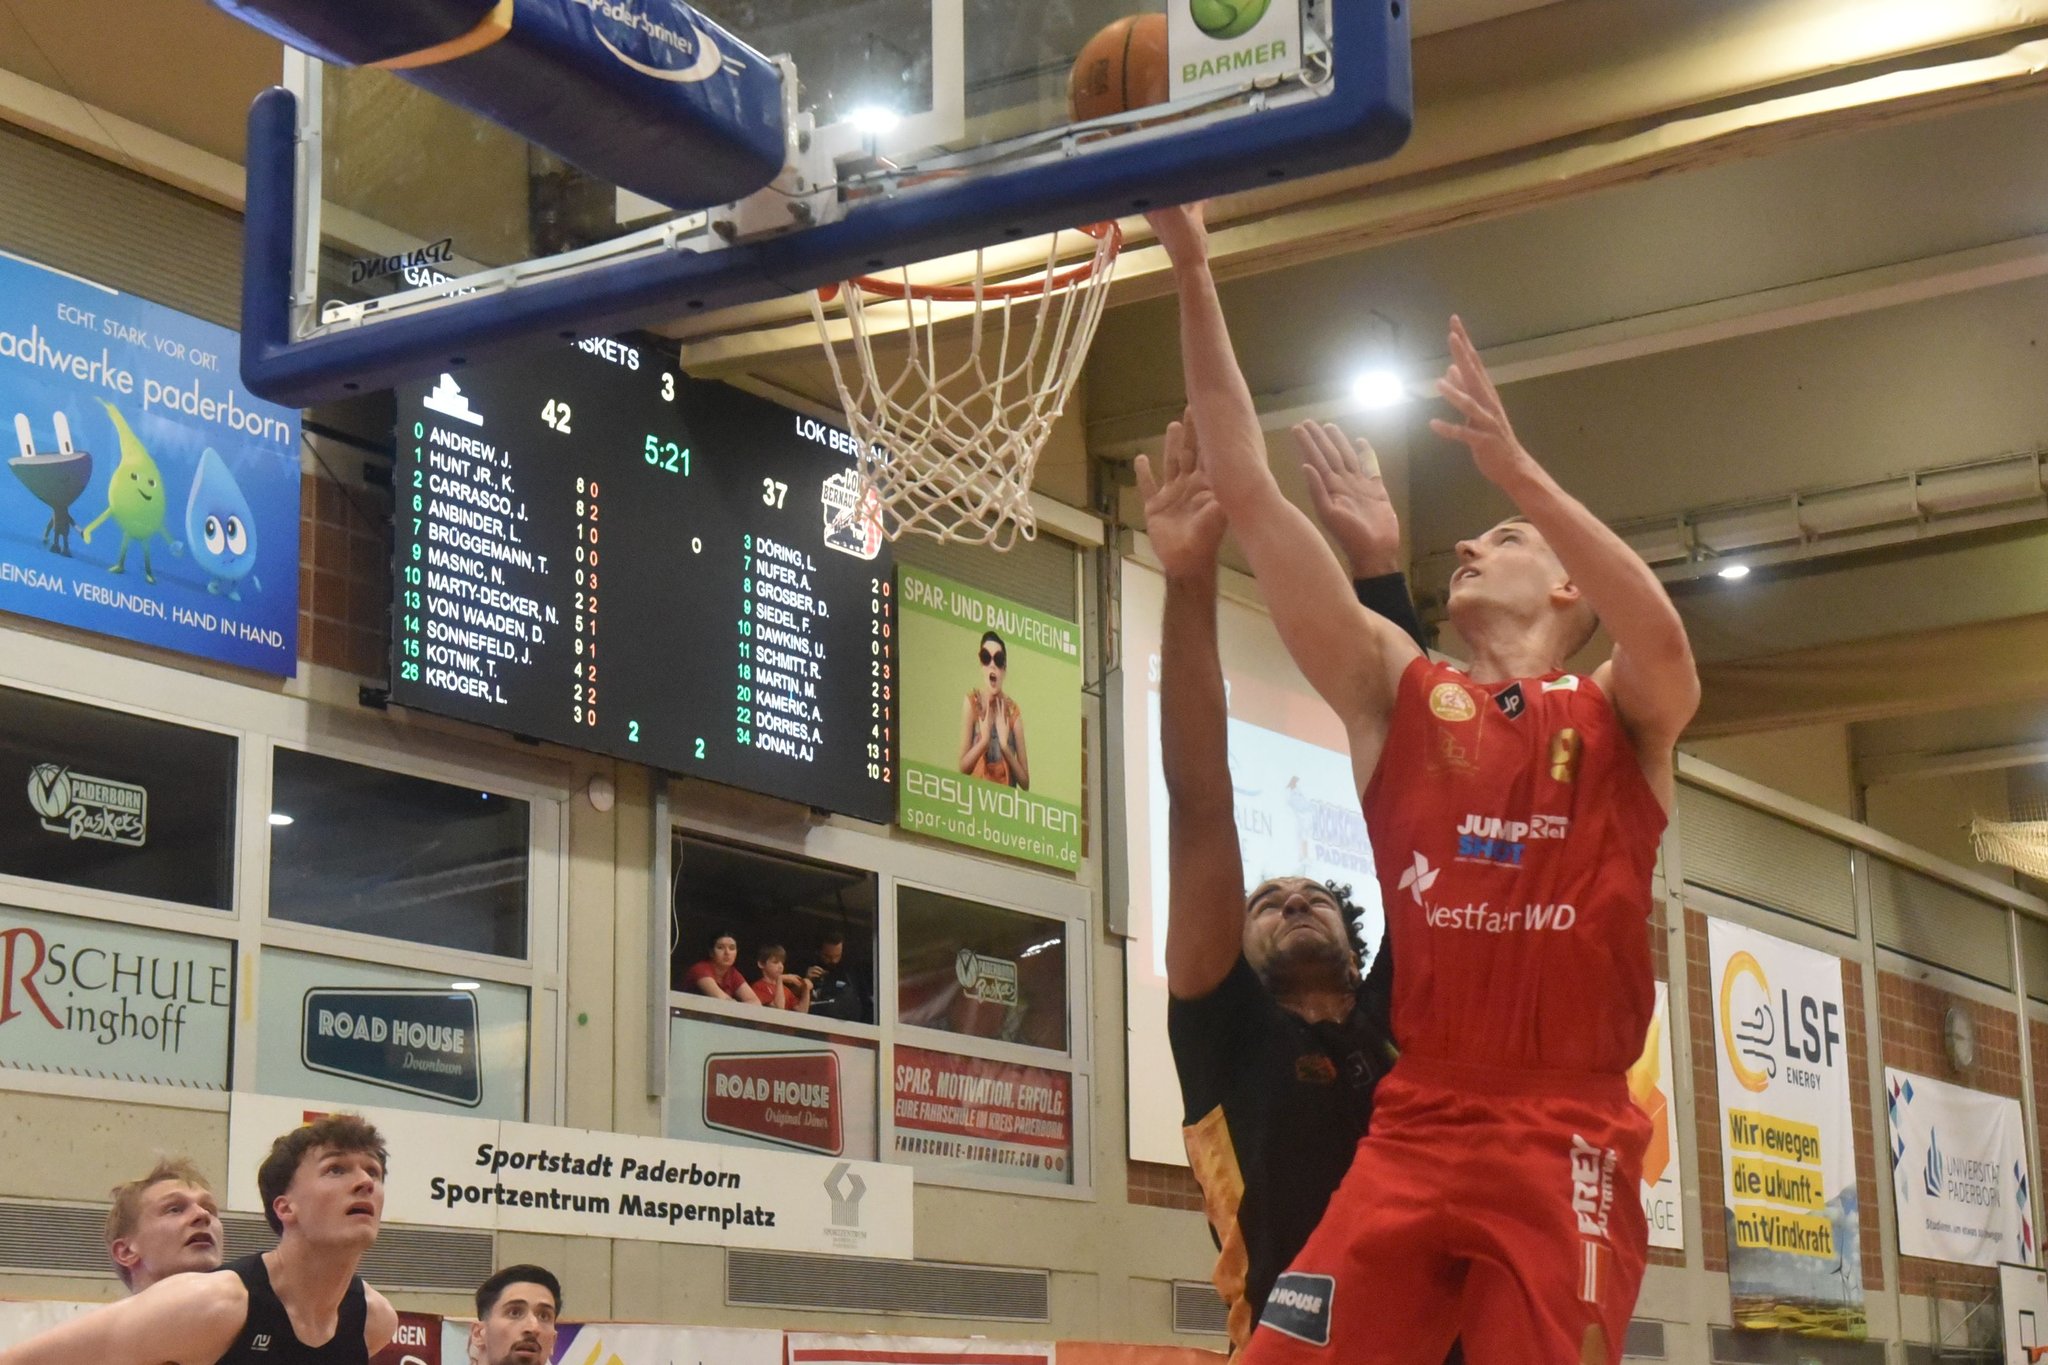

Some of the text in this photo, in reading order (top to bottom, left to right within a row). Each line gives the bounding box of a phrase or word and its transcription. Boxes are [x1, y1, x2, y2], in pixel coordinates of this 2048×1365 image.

[1182, 40, 1287, 84] BARMER
[57, 303, 220, 372] ECHT. STARK. VOR ORT.
[661, 372, 675, 401] 3
[144, 378, 290, 445] paderborn
[541, 399, 571, 435] 42
[415, 422, 512, 470] 0 ANDREW, J.
[796, 416, 826, 445] LOK
[416, 448, 516, 494] 1 HUNT JR., K.
[644, 435, 690, 477] 5:21
[414, 471, 529, 522] 2 CARRASCO, J.
[576, 478, 584, 493] 8
[763, 478, 788, 509] 37
[414, 495, 522, 543] 6 ANBINDER, L.
[576, 500, 584, 516] 8
[413, 518, 550, 574] 7 BRÜGGEMANN, T.
[576, 546, 584, 562] 0
[692, 537, 702, 553] 0
[744, 534, 816, 572] 3 DÖRING, L.
[412, 544, 506, 586] 9 MASNIC, N.
[576, 570, 584, 585] 0
[744, 556, 812, 592] 7 NUFER, A.
[404, 566, 560, 625] 10 MARTY-DECKER, N.
[576, 592, 583, 609] 2
[744, 578, 830, 618] 8 GROSBER, D.
[872, 578, 878, 593] 2
[73, 580, 285, 650] VERBUNDEN. HAND IN HAND.
[404, 590, 546, 644] 13 VON WAADEN, D.
[576, 616, 583, 632] 5
[744, 600, 812, 634] 9 SIEDEL, F.
[872, 620, 878, 634] 2
[904, 576, 1063, 651] SPAR- UND BAUVEREIN
[404, 615, 532, 665] 14 SONNEFELD, J.
[576, 638, 583, 654] 9
[738, 620, 826, 660] 10 DAWKINS, U.
[403, 638, 498, 678] 15 KOTNIK, T.
[574, 662, 582, 678] 4
[738, 642, 822, 680] 11 SCHMITT, R.
[872, 662, 878, 676] 2
[402, 662, 508, 704] 26 KRÖGER, L.
[574, 684, 582, 700] 2
[738, 664, 816, 698] 18 MARTIN, M.
[872, 682, 879, 697] 2
[574, 706, 582, 722] 3
[737, 684, 823, 722] 20 KAMERIC, A.
[872, 703, 878, 718] 2
[628, 720, 639, 743] 2
[737, 707, 823, 744] 22 DÖRRIES, A.
[872, 724, 878, 738] 4
[695, 738, 705, 759] 2
[737, 728, 814, 762] 34 JONAH, AJ
[867, 743, 879, 758] 13
[867, 763, 879, 779] 10
[72, 779, 143, 810] PADERBORN
[906, 768, 1078, 837] easy wohnen
[65, 806, 145, 840] Baskets
[907, 806, 1078, 864] spar-und-bauverein.de
[1456, 814, 1529, 842] JUMP
[1457, 834, 1526, 864] SHOT
[318, 1009, 465, 1054] ROAD HOUSE
[1781, 988, 1840, 1068] LSF
[403, 1051, 462, 1076] Downtown
[1786, 1066, 1822, 1091] ENERGY
[715, 1073, 829, 1109] ROAD HOUSE
[937, 1071, 1015, 1109] MOTIVATION.
[1017, 1083, 1065, 1116] ERFOLG.
[765, 1107, 801, 1128] Original
[1729, 1113, 1759, 1145] Wir
[475, 1143, 741, 1190] Sportstadt Paderborn
[1734, 1163, 1761, 1194] die
[430, 1176, 776, 1229] Sportzentrum Maspernplatz
[1737, 1212, 1768, 1243] mit
[1276, 1288, 1323, 1314] HOUSE
